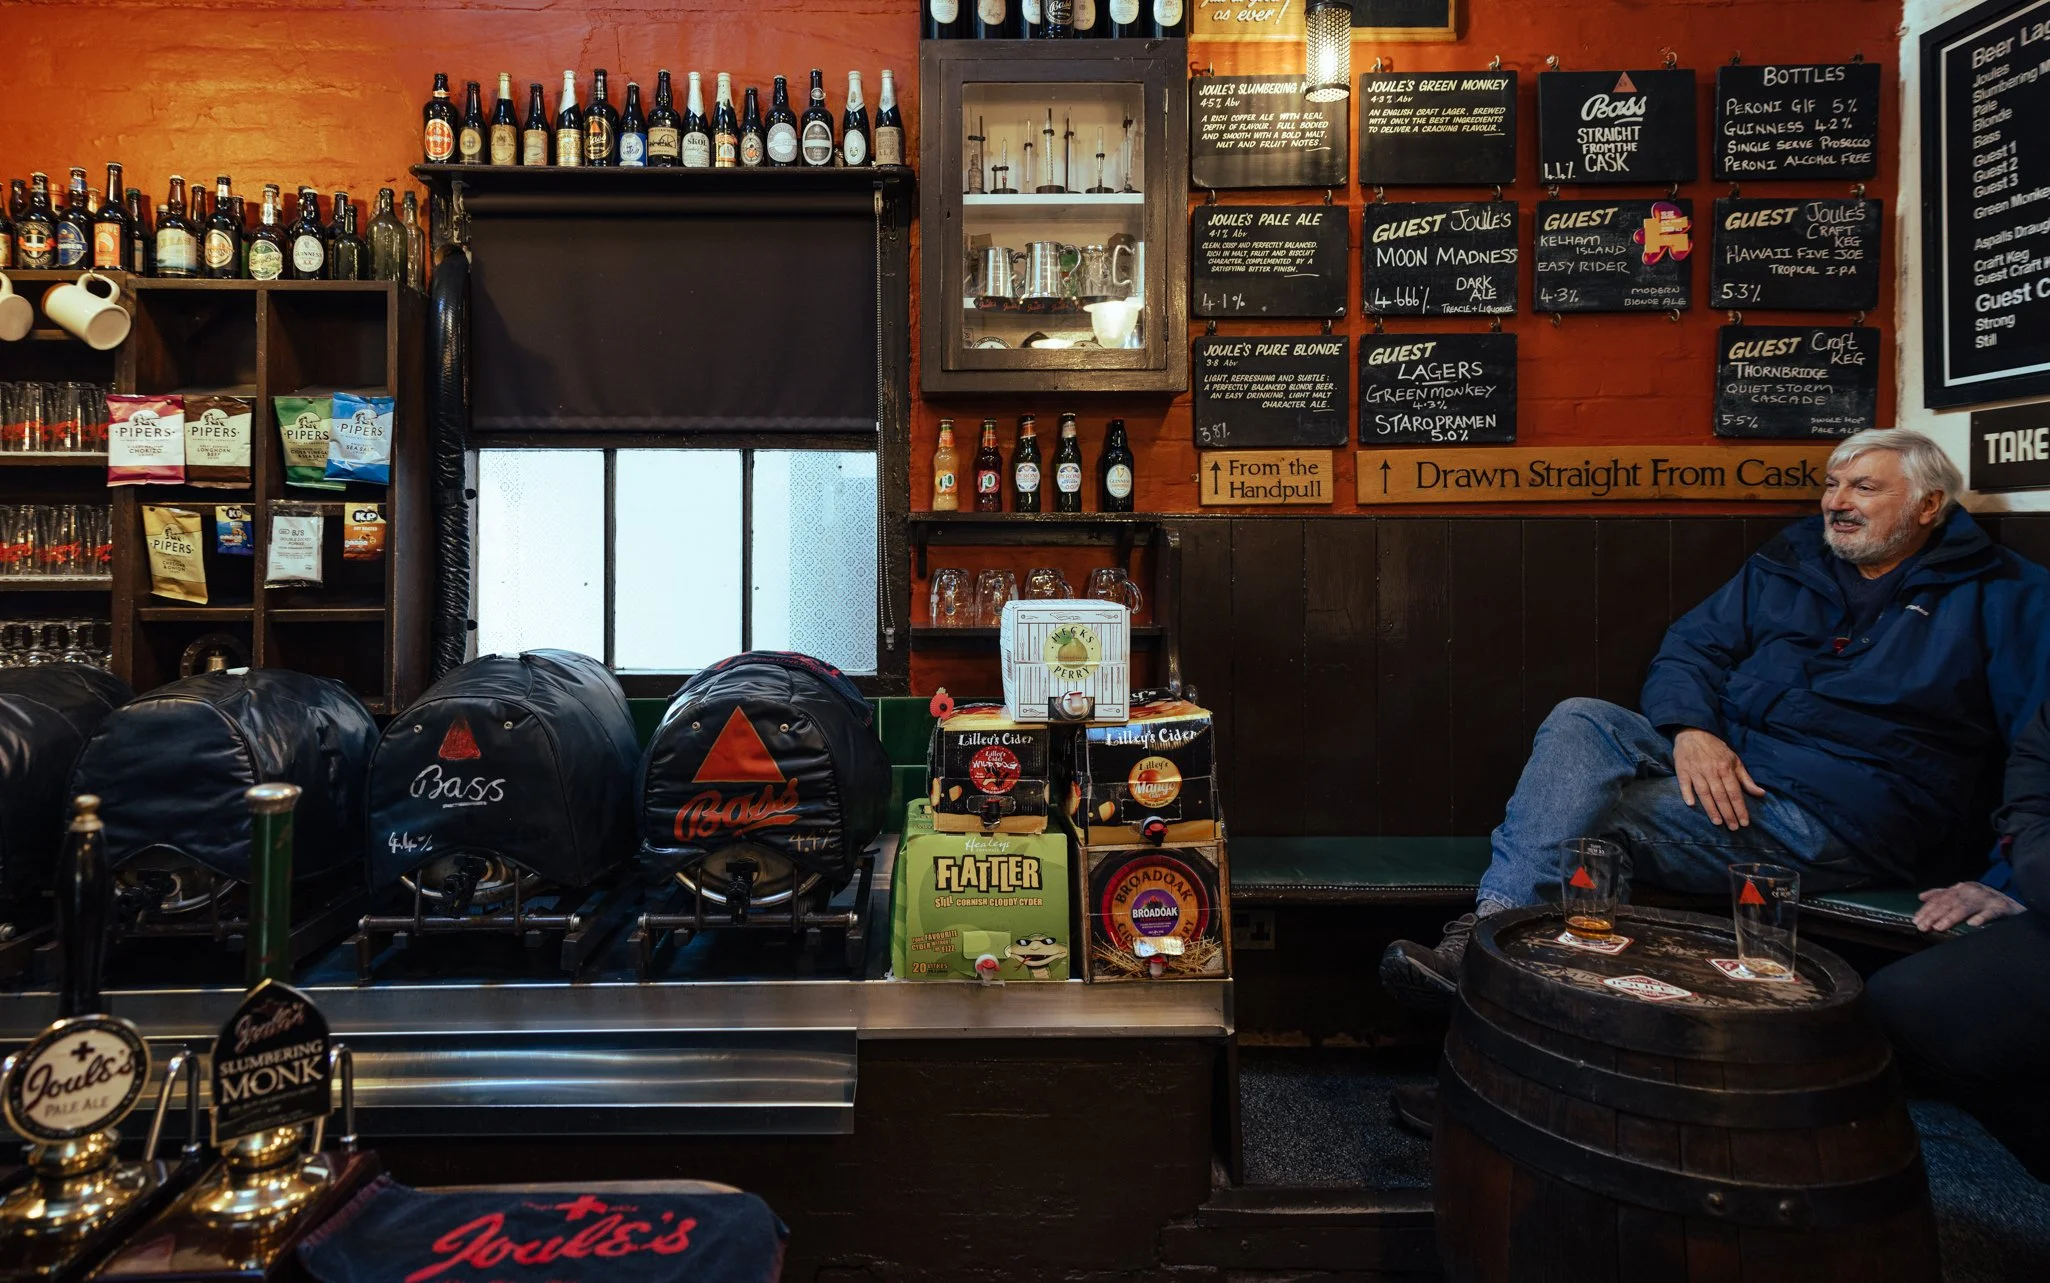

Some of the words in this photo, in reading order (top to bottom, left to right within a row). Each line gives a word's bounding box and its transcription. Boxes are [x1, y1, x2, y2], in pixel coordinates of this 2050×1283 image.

[1213, 9, 1229, 22] as
[1972, 36, 2015, 69] Beer
[1763, 66, 1846, 87] BOTTLES
[1972, 63, 2010, 88] Joules
[1199, 84, 1235, 96] JOULE'S
[1238, 82, 1298, 95] SLUMBERING
[1368, 80, 1415, 93] JOULE'S
[1419, 79, 1458, 92] GREEN
[1461, 79, 1509, 91] MONKEY
[1972, 67, 2039, 104] Slumbering
[1382, 108, 1413, 116] ENGLISH
[1416, 108, 1440, 116] CRAFT
[1473, 107, 1506, 115] BREWED
[1581, 93, 1647, 121] Bass
[1726, 97, 1782, 115] PERONI
[1973, 99, 1998, 118] Pale
[1300, 121, 1329, 129] BODIED
[1369, 117, 1387, 125] WITH
[1390, 117, 1410, 125] ONLY
[1429, 116, 1451, 124] BEST
[1724, 120, 1804, 136] GUINNESS
[1973, 107, 2013, 132] Blonde
[1202, 133, 1219, 141] AND
[1223, 132, 1252, 140] SMOOTH
[1282, 131, 1302, 139] BOLD
[1380, 125, 1411, 133] DELIVER
[1422, 125, 1459, 133] CRACKING
[1577, 126, 1642, 144] STRAIGHT
[1216, 140, 1235, 149] NUT
[1238, 140, 1257, 148] AND
[1260, 140, 1288, 148] FRUIT
[1727, 140, 1771, 154] SINGLE
[1973, 130, 2001, 149] Bass
[1585, 152, 1630, 173] CASK
[1724, 155, 1778, 172] PERONI
[1784, 155, 1837, 167] ALCOHOL
[1841, 152, 1872, 165] FREE
[1973, 144, 2008, 167] Guest
[2009, 140, 2017, 154] 1
[1973, 160, 2008, 183] Guest
[2009, 156, 2018, 171] 2
[1973, 176, 2008, 199] Guest
[2009, 172, 2018, 187] 3
[1973, 200, 2009, 219] Green
[2010, 186, 2050, 208] Monke
[1208, 212, 1253, 226] JOULE'S
[1258, 213, 1291, 226] PALE
[1296, 213, 1323, 226] ALE
[1373, 213, 1447, 243] GUEST
[1544, 207, 1618, 231] GUEST
[1724, 207, 1799, 231] GUEST
[1806, 223, 1856, 240] CRAFT
[1974, 230, 2013, 251] Aspalls
[1540, 235, 1601, 247] KELHAM
[1834, 236, 1862, 248] KEG
[1376, 246, 1428, 267] MOON
[1436, 247, 1518, 266] MADNESS
[1576, 245, 1627, 256] ISLAND
[1726, 245, 1793, 265] HAWAII
[1797, 247, 1830, 260] FIVE
[1833, 249, 1864, 261] JOE
[1537, 261, 1575, 274] EASY
[1579, 261, 1631, 274] RIDER
[1974, 254, 2004, 272] Craft
[2005, 249, 2030, 264] Keg
[1768, 264, 1820, 277] TROPICAL
[1974, 268, 2008, 286] Guest
[2009, 257, 2042, 278] Craft
[1456, 275, 1493, 291] DARK
[1469, 288, 1497, 302] ALE
[1975, 282, 2032, 312] Guest
[1975, 314, 2016, 332] Strong
[1203, 342, 1252, 357] JOULE'S
[1255, 343, 1290, 356] PURE
[1293, 343, 1342, 356] BLONDE
[1728, 336, 1802, 360] GUEST
[1811, 332, 1859, 354] Craft
[1975, 333, 1997, 349] Still
[1368, 341, 1437, 366] GUEST
[1831, 352, 1867, 366] KEG
[1231, 374, 1276, 382] REFRESHING
[1397, 361, 1483, 380] LAGERS
[1730, 361, 1830, 380] THORNBRIDGE
[1212, 383, 1249, 391] PERFECTLY
[1251, 383, 1287, 391] BALANCED
[1312, 391, 1332, 399] MALT
[1366, 384, 1427, 404] GREEN
[1430, 383, 1497, 399] MONKEY
[1726, 383, 1773, 395] QUIET
[1776, 384, 1834, 395] STORM
[1262, 400, 1306, 409] CHARACTER
[1751, 395, 1827, 406] CASCADE
[120, 427, 171, 438] PIPERS
[191, 427, 237, 438] PIPERS
[340, 423, 383, 437] PIPERS
[1375, 413, 1497, 435] STAROPRAMEN
[287, 430, 330, 440] PIPERS
[1984, 427, 2049, 464] TAKE
[1229, 459, 1281, 476] From
[1289, 458, 1319, 476] the
[1416, 460, 1521, 491] Drawn
[1528, 458, 1643, 497] Straight
[1651, 457, 1726, 487] From
[1736, 458, 1820, 488] Cask
[1229, 478, 1322, 504] Handpull
[228, 508, 242, 518] KP
[355, 512, 377, 522] KP
[153, 539, 192, 554] PIPERS
[1054, 665, 1090, 680] PERRY
[1002, 732, 1034, 745] Cider
[1105, 729, 1156, 749] Lilley's
[1158, 728, 1197, 744] Cider
[410, 764, 506, 804] Bass
[1134, 781, 1175, 796] Mango
[673, 778, 801, 843] Bass
[1115, 869, 1194, 904] BROADOAK
[957, 898, 988, 906] CORNISH
[989, 898, 1018, 906] CLOUDY
[1019, 898, 1043, 906] CYDER
[1132, 906, 1179, 919] BROADOAK
[912, 962, 927, 973] 20
[219, 1039, 324, 1077] SLUMBERING
[24, 1048, 137, 1116] Joule's
[220, 1055, 325, 1104] MONK
[44, 1101, 79, 1119] PALE
[82, 1096, 109, 1114] ALE
[404, 1211, 698, 1283] Joule's
